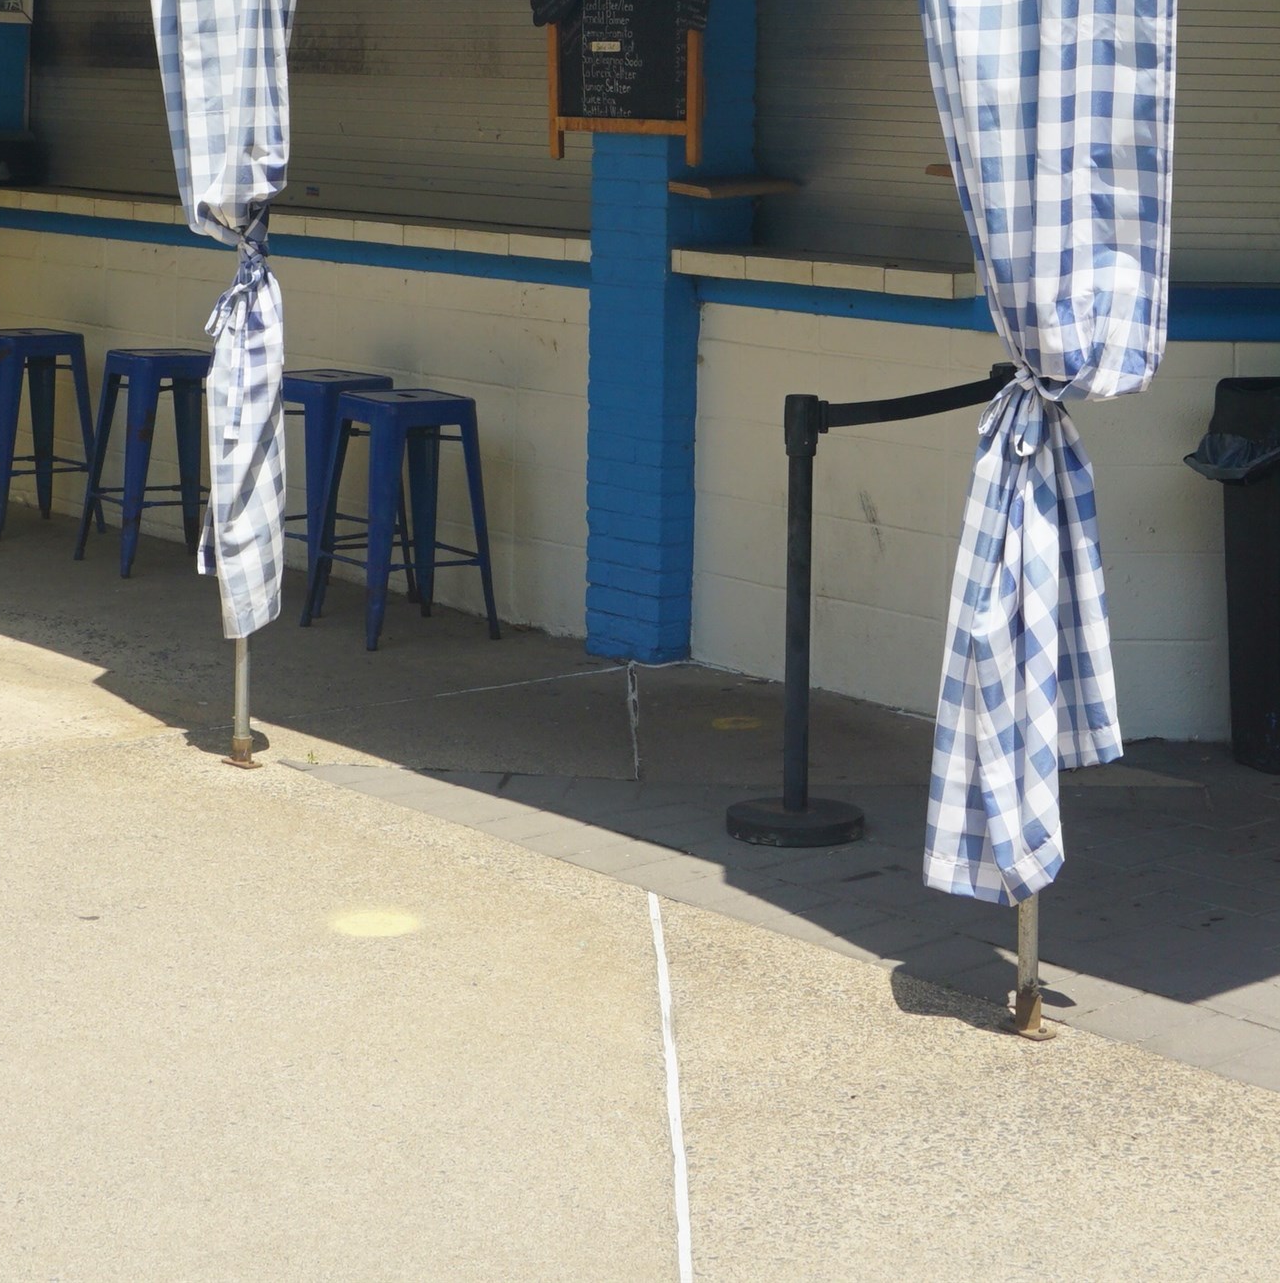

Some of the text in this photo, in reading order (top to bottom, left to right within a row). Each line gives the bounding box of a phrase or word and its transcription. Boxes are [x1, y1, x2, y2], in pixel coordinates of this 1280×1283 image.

[582, 10, 630, 25] Arnold Palmer
[624, 52, 643, 67] Soda
[605, 78, 631, 95] Seltzer
[581, 94, 601, 106] Juice
[609, 105, 632, 117] Water
